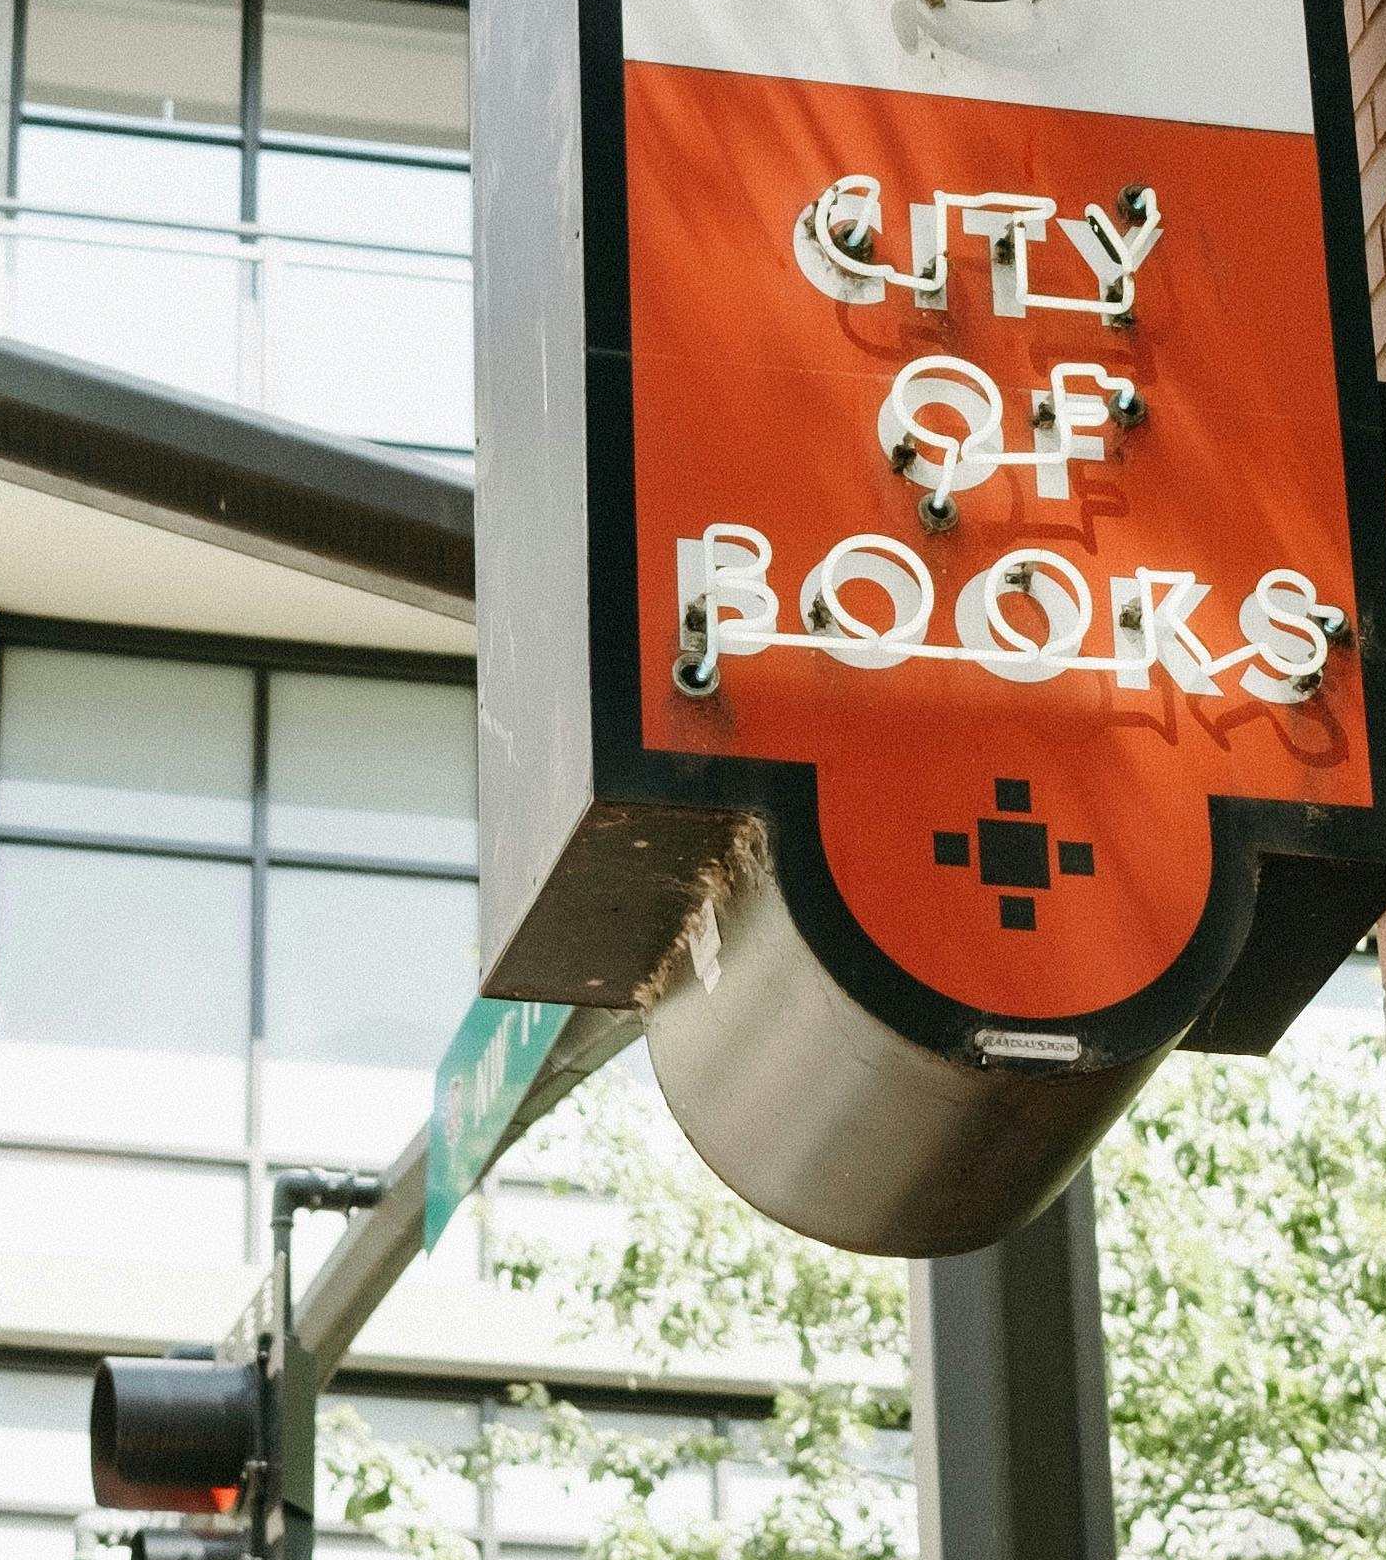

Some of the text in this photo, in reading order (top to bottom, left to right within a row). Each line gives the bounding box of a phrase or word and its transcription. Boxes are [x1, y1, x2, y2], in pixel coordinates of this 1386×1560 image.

[794, 174, 1162, 326] CITY
[877, 355, 1133, 501] OF
[675, 524, 1345, 704] BOOKS
